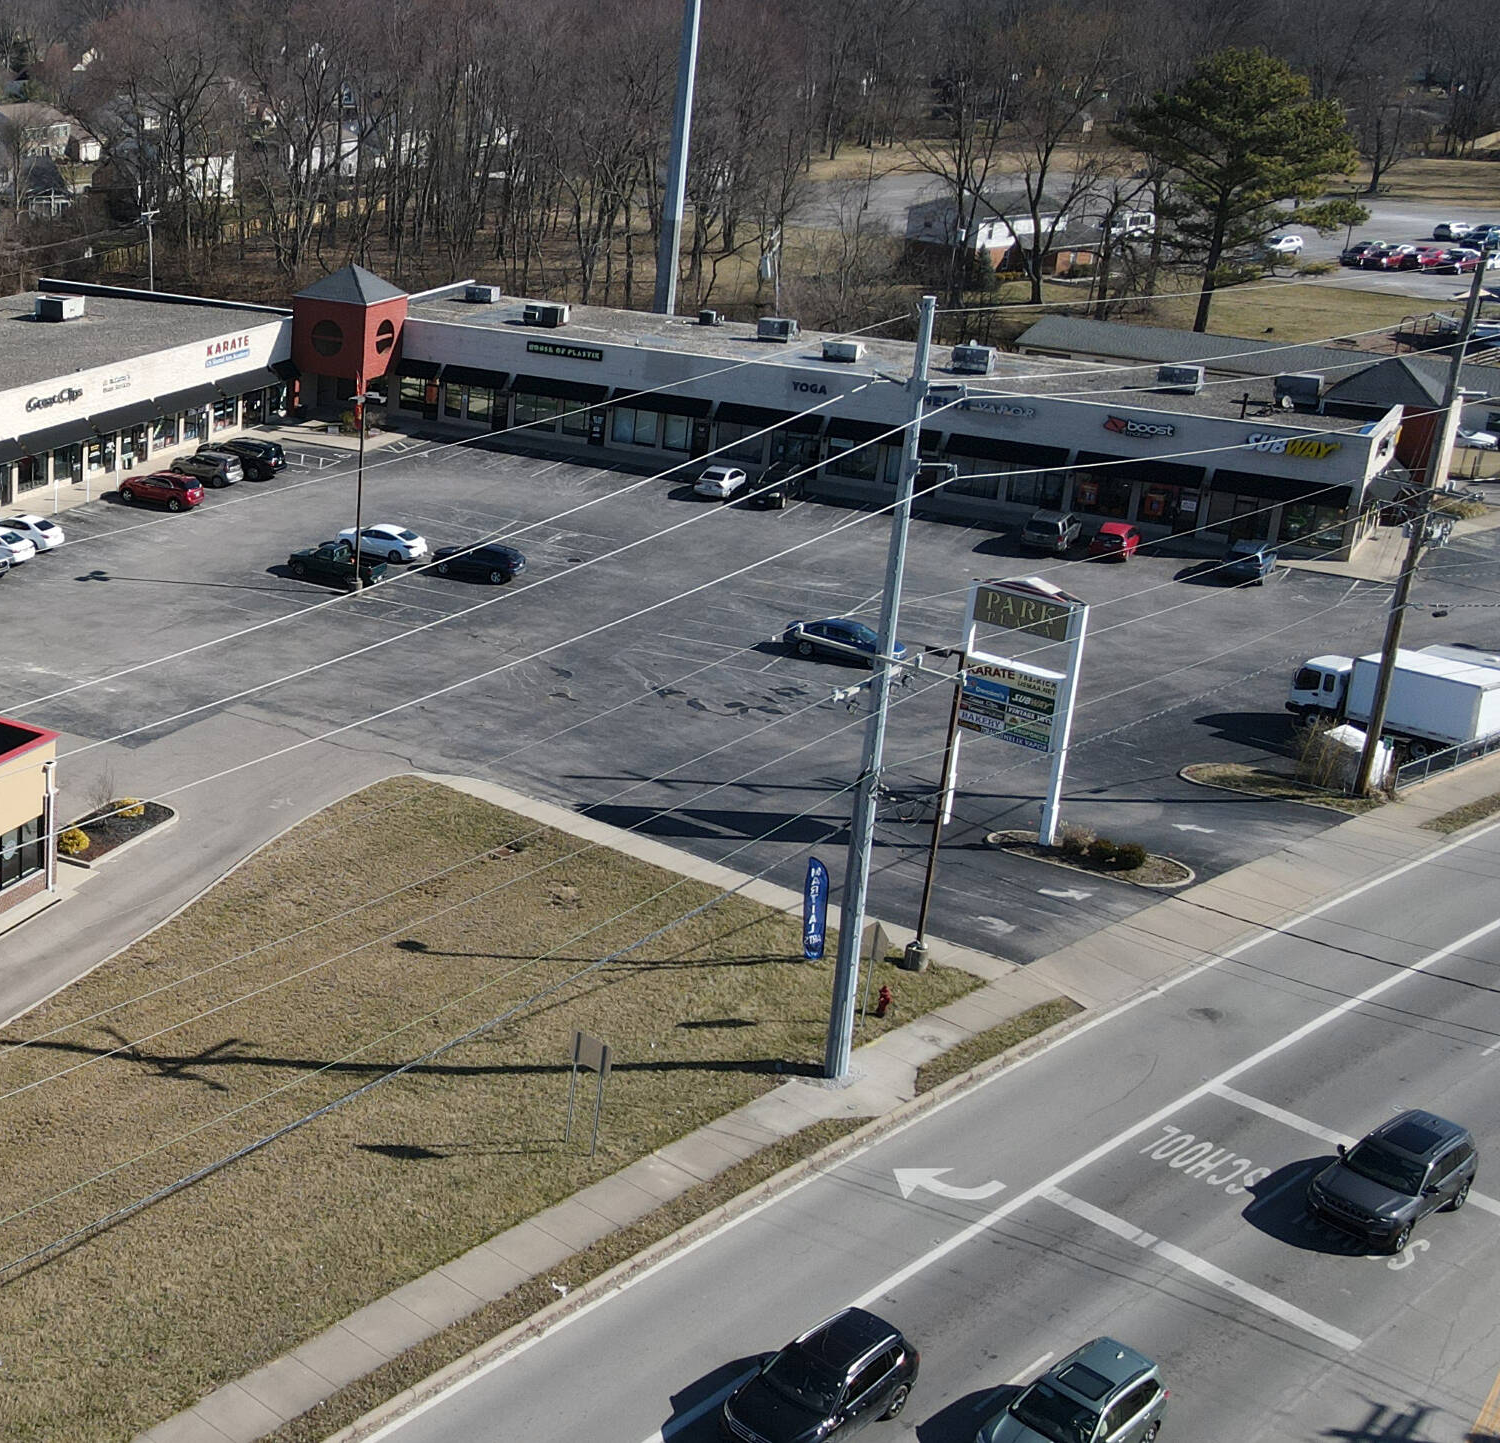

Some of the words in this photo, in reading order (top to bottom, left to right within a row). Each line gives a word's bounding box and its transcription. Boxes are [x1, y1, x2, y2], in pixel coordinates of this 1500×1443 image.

[206, 335, 249, 356] KARATE
[792, 381, 827, 395] YOGA
[1127, 420, 1174, 437] boost
[1243, 433, 1342, 460] SUBWAY
[986, 591, 1056, 625] PARK
[967, 663, 1016, 680] KARATE
[1011, 693, 1054, 709] SUBWAY
[1139, 1124, 1273, 1195] SCHOOL
